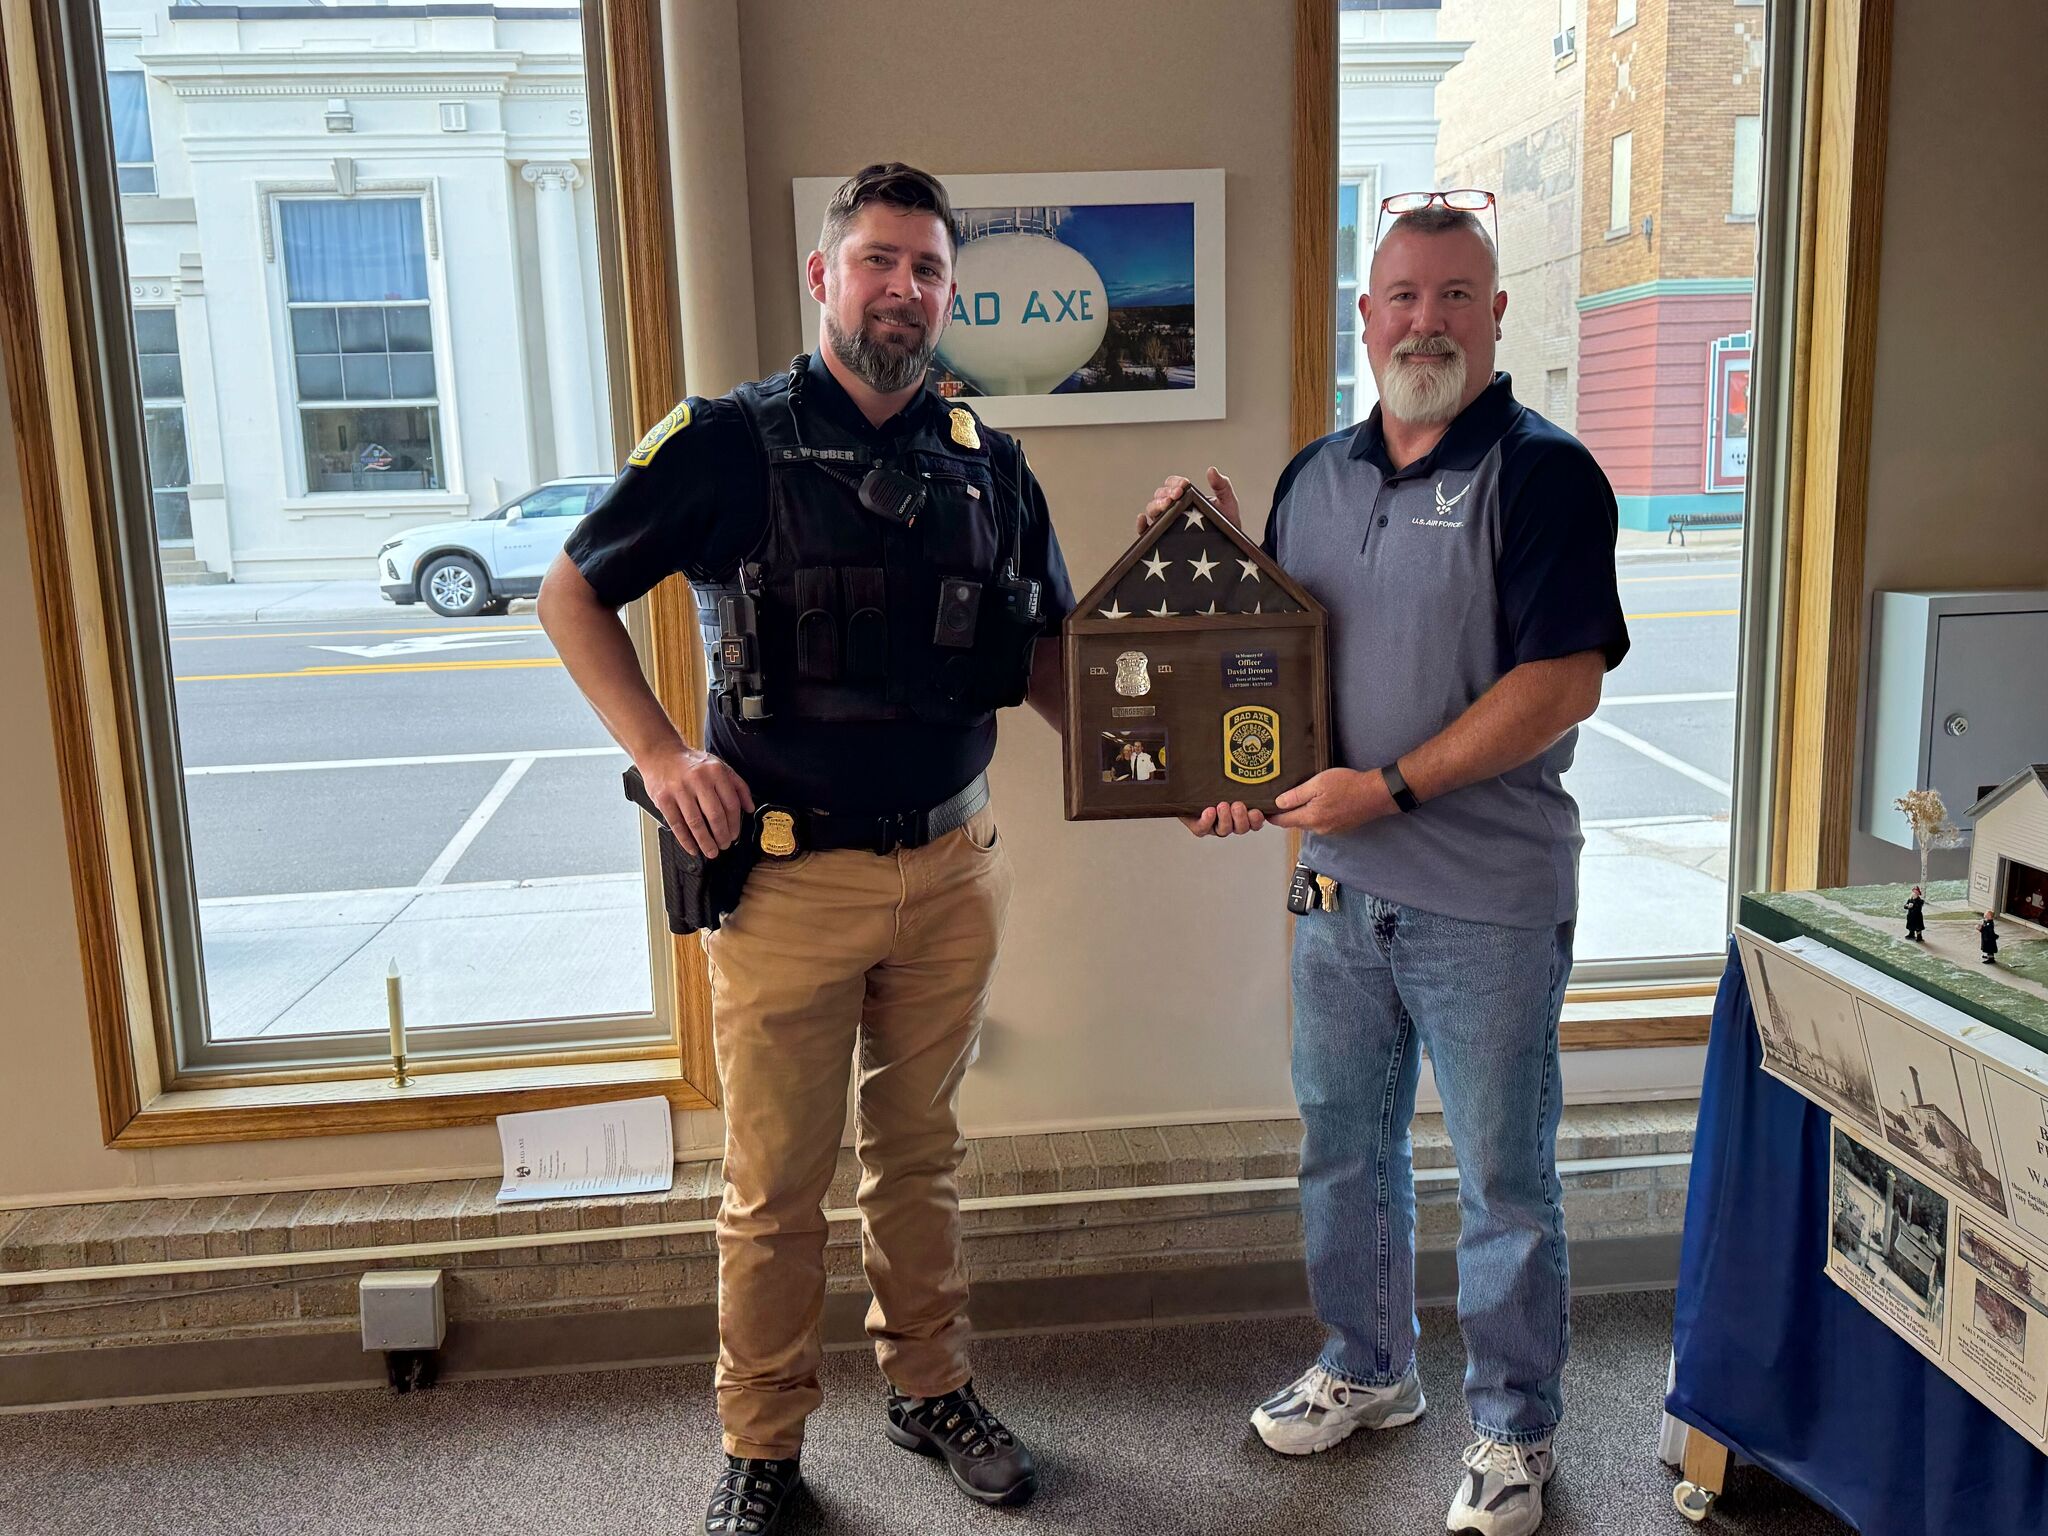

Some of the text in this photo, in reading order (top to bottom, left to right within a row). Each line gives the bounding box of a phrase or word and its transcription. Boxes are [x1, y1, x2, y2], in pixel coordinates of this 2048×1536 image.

[951, 290, 1094, 326] AD AXE
[783, 447, 854, 461] S. WEBBER
[1411, 517, 1463, 528] U.S. AIR FORCE
[1227, 668, 1247, 676] David
[1234, 712, 1270, 724] BAD AXE
[1238, 767, 1268, 777] POLICE
